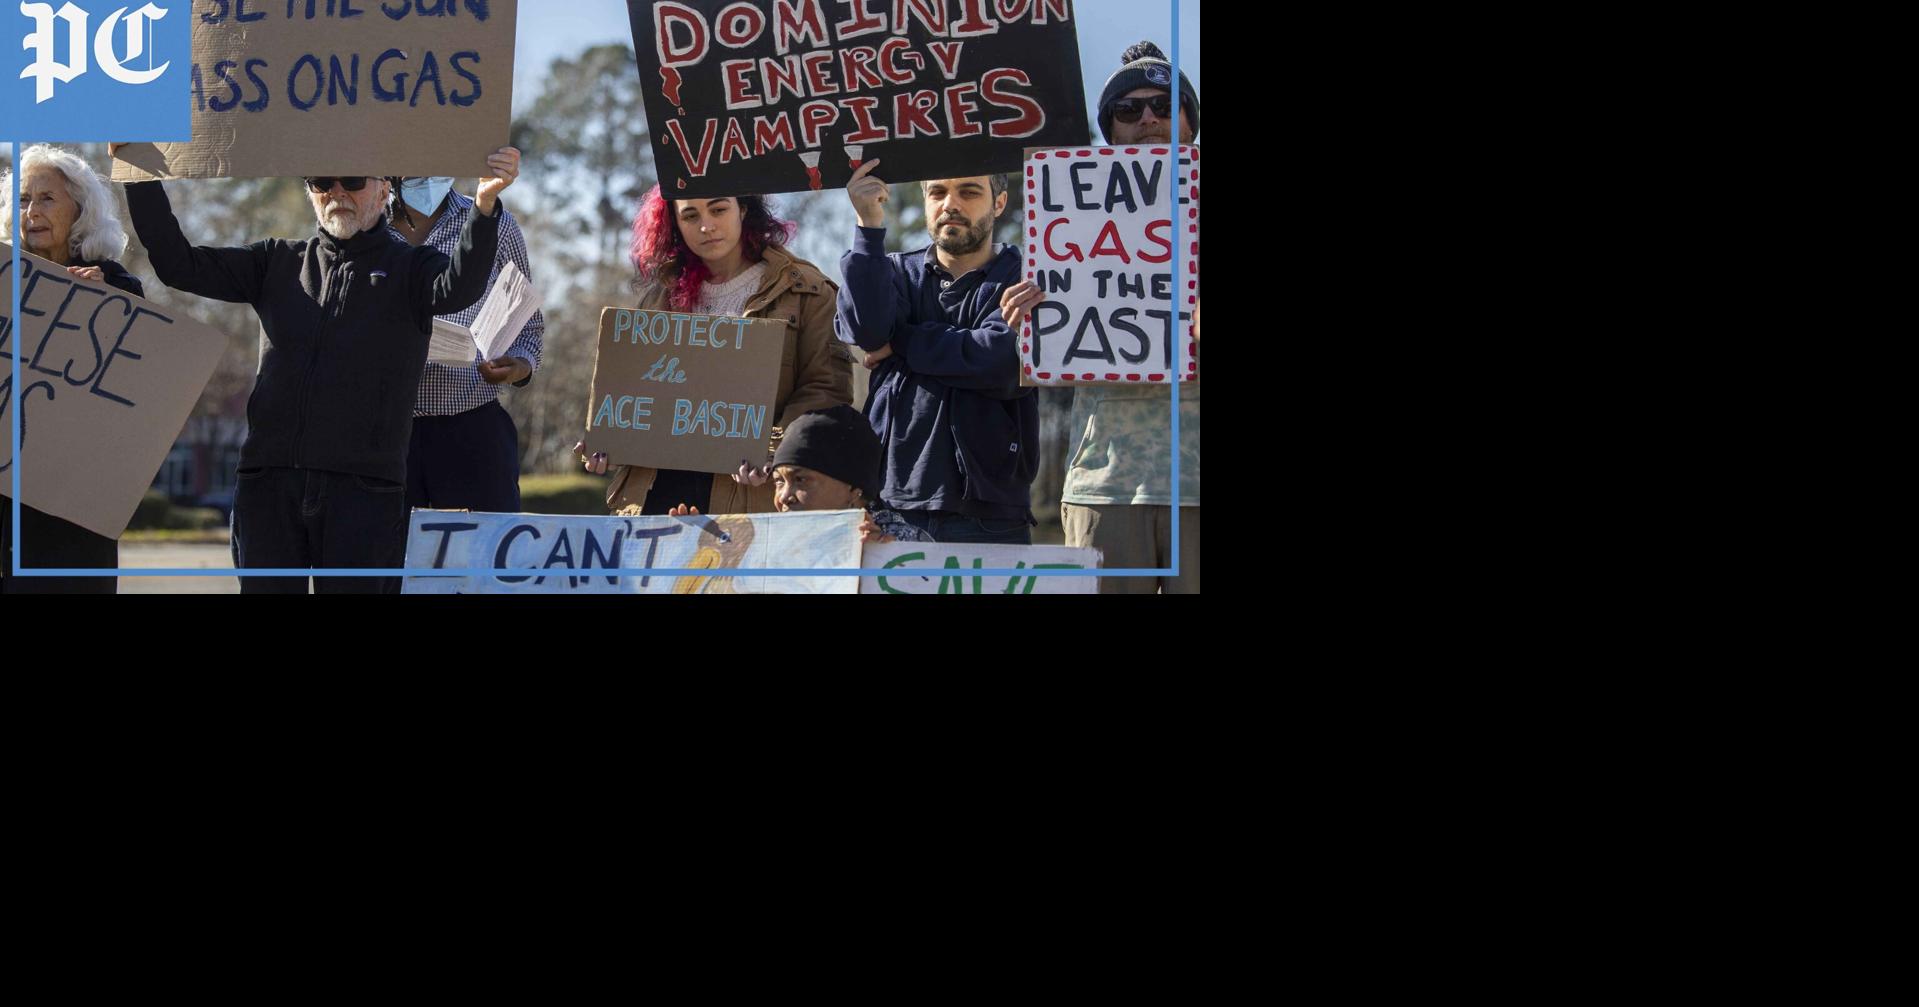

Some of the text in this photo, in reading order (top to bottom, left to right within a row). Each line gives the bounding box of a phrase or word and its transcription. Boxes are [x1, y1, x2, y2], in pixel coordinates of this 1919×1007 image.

[287, 54, 359, 111] ON
[371, 49, 482, 107] GAS
[666, 68, 1046, 177] VAMPIRES
[1043, 217, 1173, 264] GAS
[1037, 268, 1172, 299] IN THE
[613, 309, 753, 350] PROTECT
[1031, 301, 1191, 370] PAST
[640, 354, 688, 384] the
[593, 394, 766, 440] ACE BASIN
[494, 520, 683, 588] CAN'T
